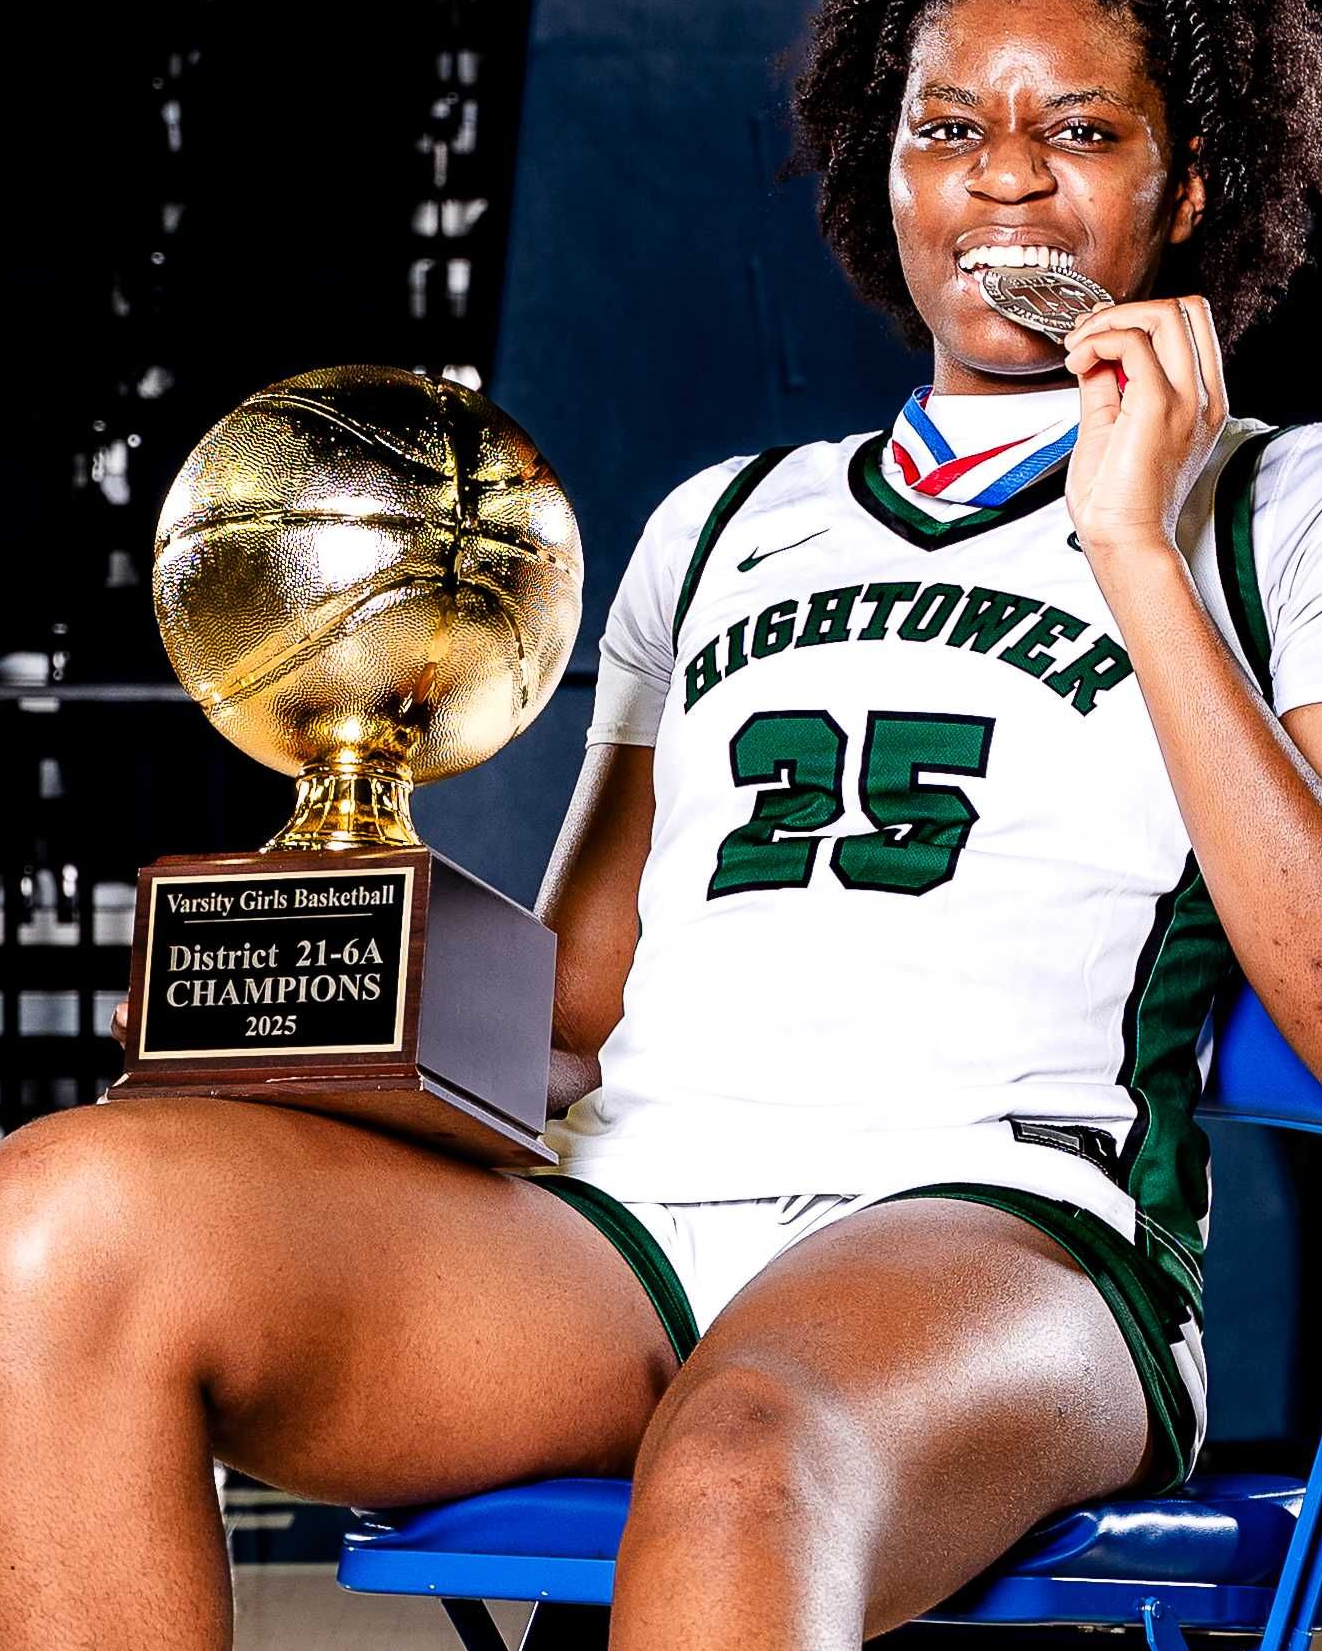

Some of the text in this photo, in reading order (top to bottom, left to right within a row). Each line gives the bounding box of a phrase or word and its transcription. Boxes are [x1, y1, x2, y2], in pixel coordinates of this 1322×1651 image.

[684, 582, 1135, 717] HIGHTOWER
[706, 710, 996, 901] 25
[167, 885, 394, 916] Varsity Girls Basketball
[168, 938, 383, 972] District 21-6A
[166, 973, 381, 1007] CHAMPIONS
[245, 1015, 297, 1036] 2025
